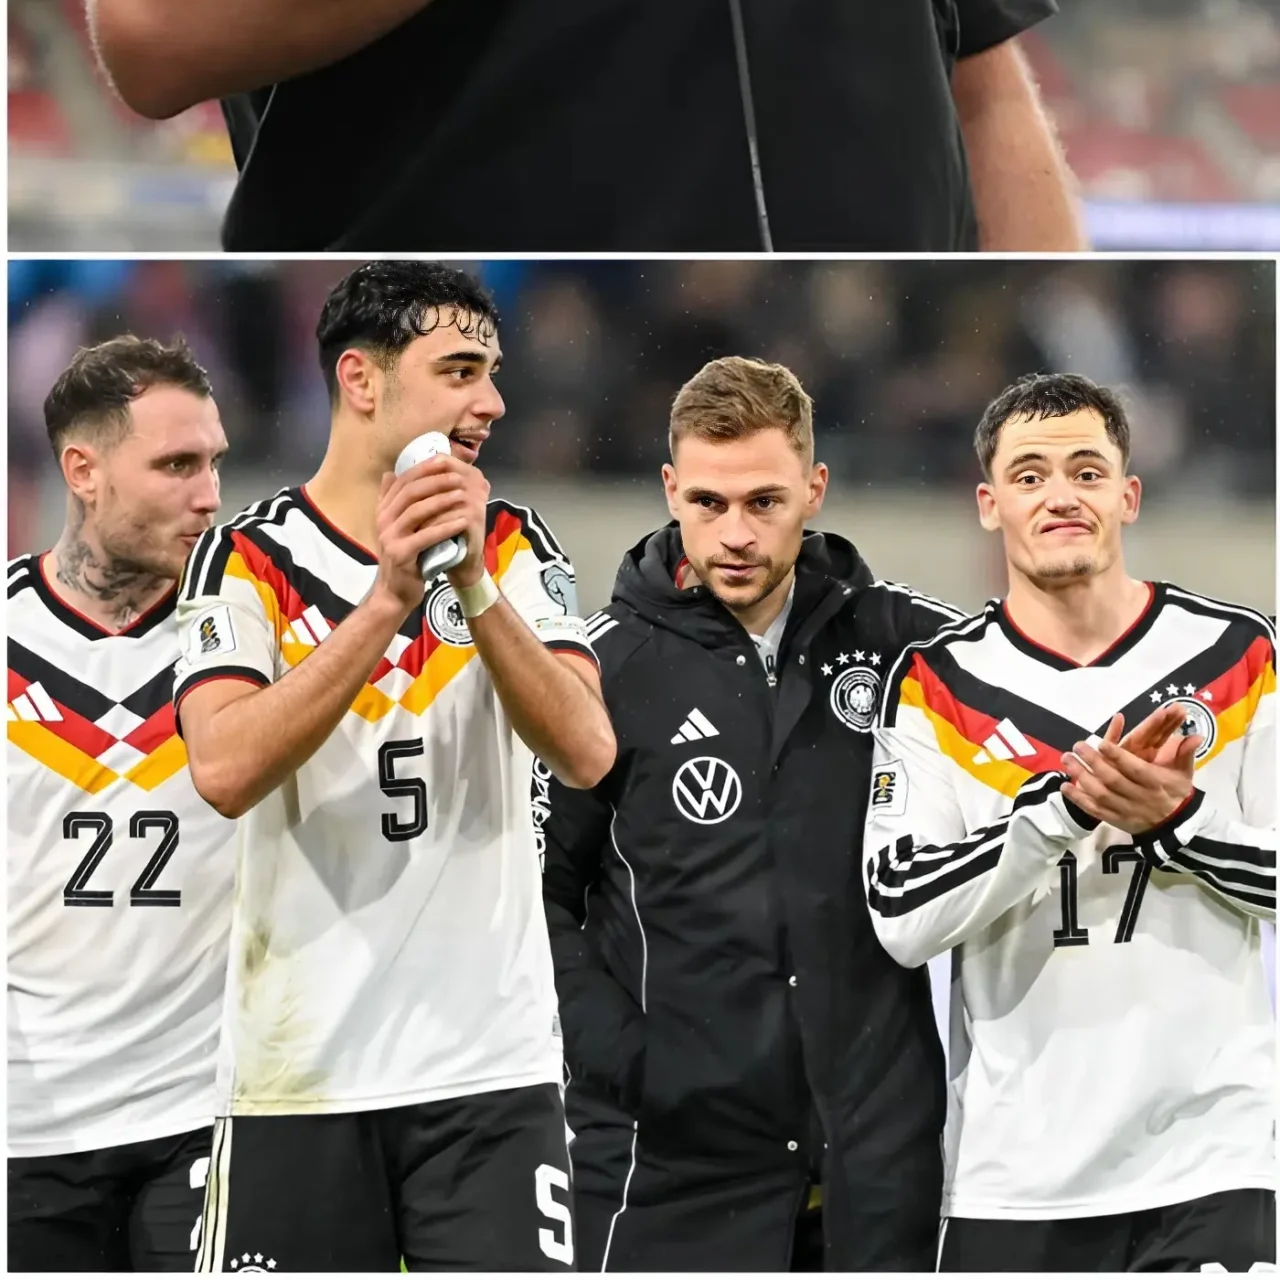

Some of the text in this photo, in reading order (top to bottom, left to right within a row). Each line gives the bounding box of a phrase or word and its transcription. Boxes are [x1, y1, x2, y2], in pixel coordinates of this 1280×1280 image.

[378, 737, 428, 842] 5
[62, 810, 182, 908] 22
[1053, 844, 1152, 948] 17
[534, 1163, 575, 1267] 5
